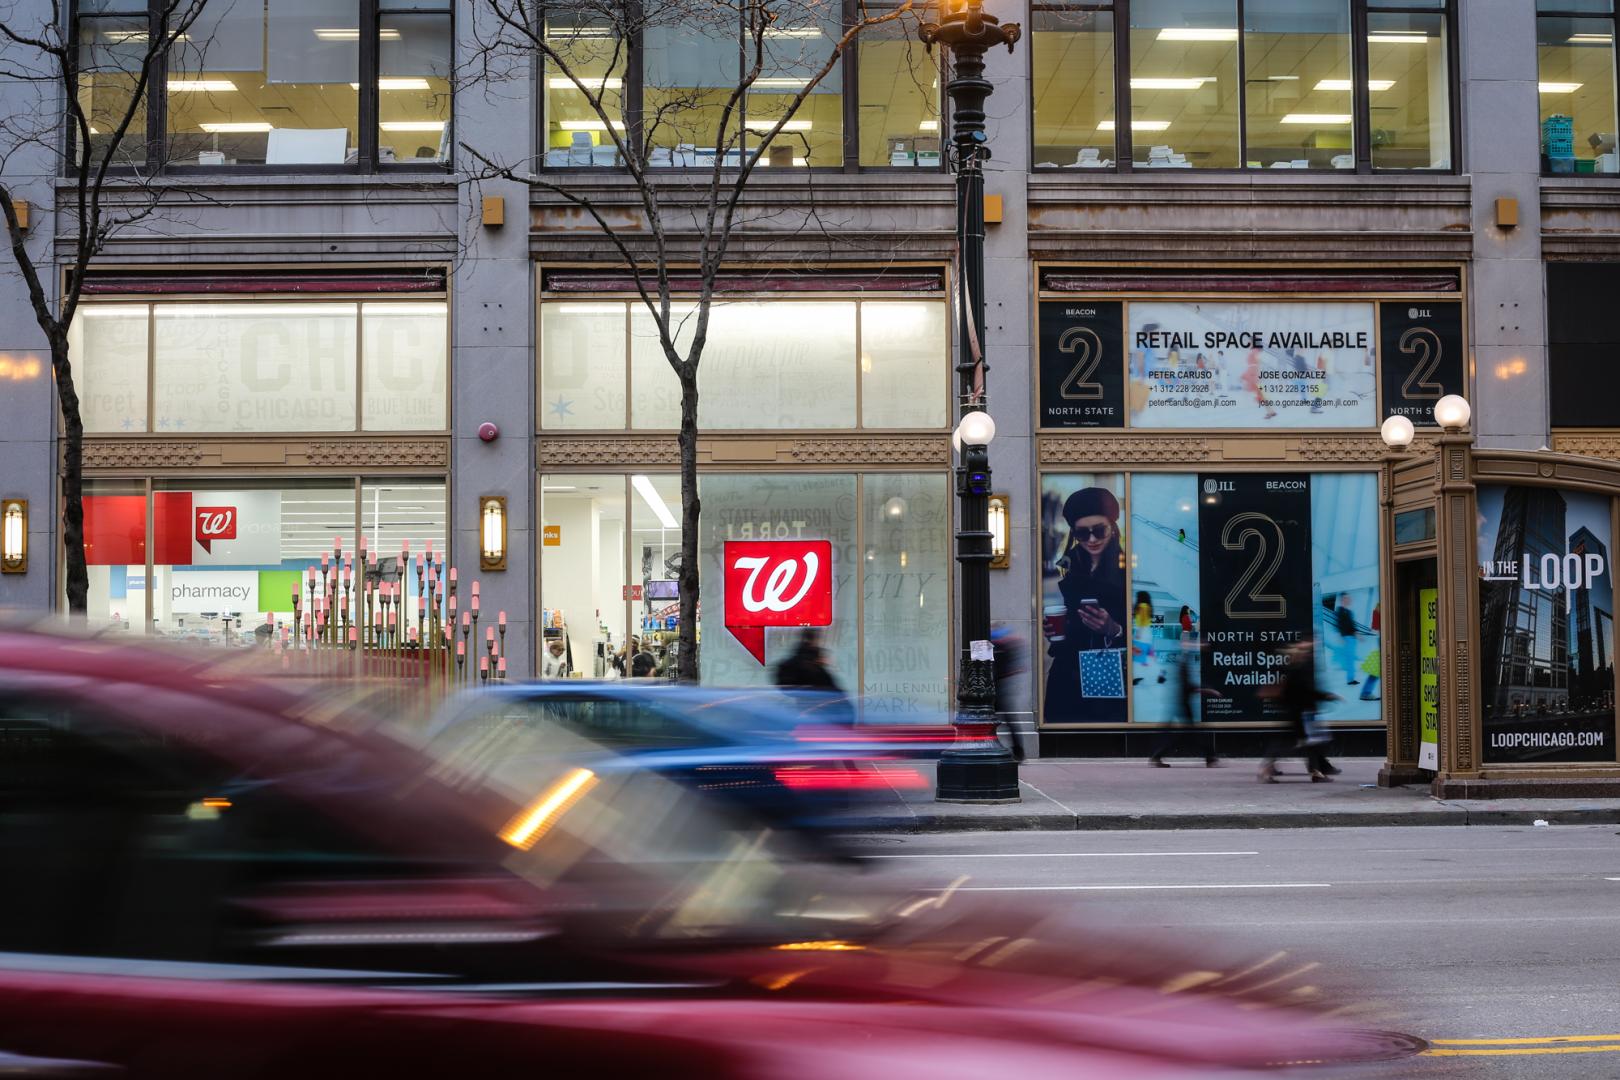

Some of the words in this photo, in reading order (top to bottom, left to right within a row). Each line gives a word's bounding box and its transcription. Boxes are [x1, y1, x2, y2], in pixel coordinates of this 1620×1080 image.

[1065, 308, 1096, 316] BEACON
[1418, 309, 1432, 318] JLL
[1136, 331, 1199, 349] RETAIL
[1204, 331, 1263, 349] SPACE
[1268, 331, 1367, 349] AVAILABLE
[1059, 326, 1104, 400] 2
[1399, 326, 1444, 400] 2
[1148, 370, 1175, 379] PETER
[1177, 370, 1212, 379] CARUSO
[1258, 371, 1280, 380] JOSE
[1281, 371, 1327, 380] GONZALEZ
[1149, 384, 1158, 393] +1
[1160, 384, 1174, 393] 312
[1175, 384, 1189, 393] 228
[1191, 384, 1209, 393] 2926
[1259, 385, 1267, 393] +1
[1269, 385, 1284, 393] 312
[1285, 385, 1299, 393] 228
[1301, 385, 1320, 393] 2155
[237, 397, 336, 420] CHICAGO
[1048, 407, 1081, 415] NORTH
[1084, 407, 1114, 415] STATE
[1390, 407, 1422, 415] NORTH
[1218, 481, 1236, 491] JLL
[1266, 480, 1307, 489] BEACON
[769, 508, 831, 527] MADISON
[1221, 511, 1287, 618] 2
[1483, 561, 1494, 574] IN
[1496, 561, 1518, 574] THE
[1523, 553, 1604, 590] LOOP
[172, 583, 250, 600] pharmacy
[1207, 631, 1254, 642] NORTH
[1260, 631, 1301, 642] STATE
[1213, 651, 1252, 666] Retail
[1256, 651, 1291, 669] Spac
[1491, 731, 1604, 748] LOOPCHICAGO.COM
